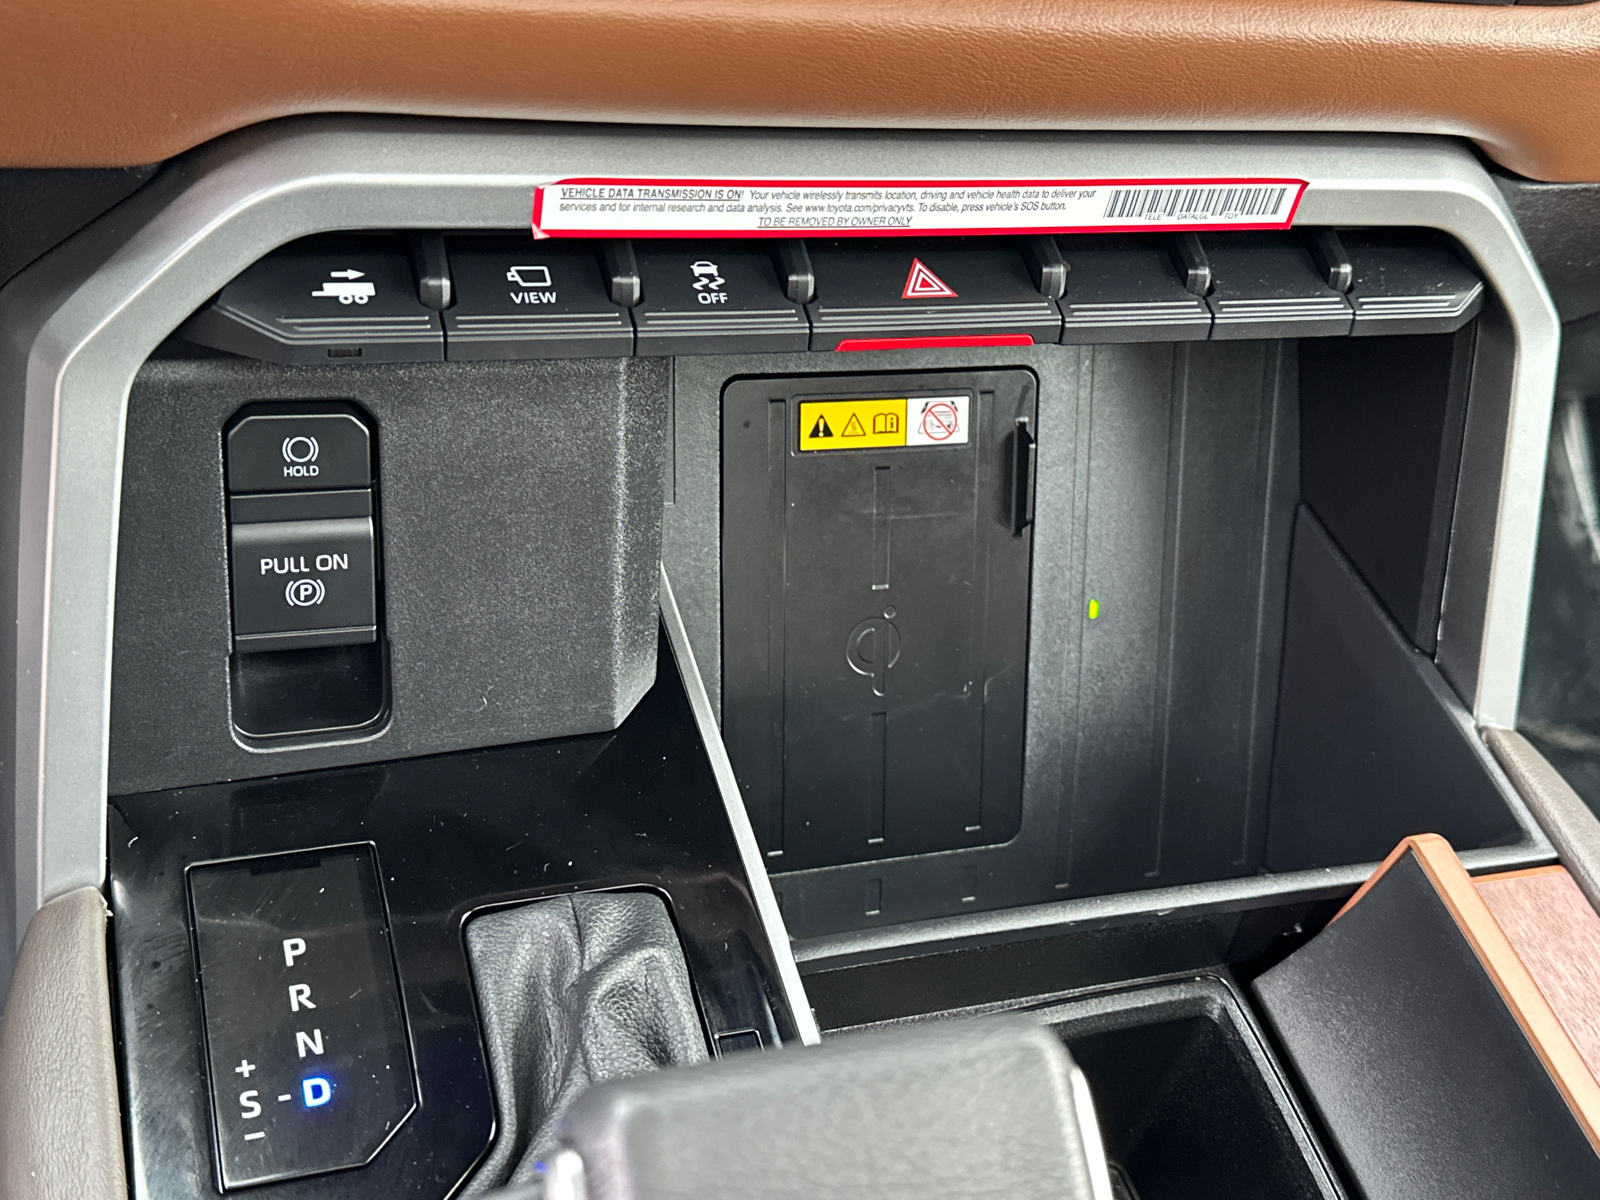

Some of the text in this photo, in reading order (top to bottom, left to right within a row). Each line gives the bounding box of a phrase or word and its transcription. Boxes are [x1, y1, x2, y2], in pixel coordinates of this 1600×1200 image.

[561, 188, 1097, 202] VEHICLE DATA TRANSMISSION IS ON! Your vehicle wirelessly transmits location, driving and vehicle health data to deliver your
[560, 201, 1066, 214] services and for internal research and data analysis. See www.toyota.com/privacyvts. To disable, press vehicle's SOS button.
[758, 216, 913, 226] TO BE REMOVED BY OWNER ONLY
[1143, 213, 1163, 221] TELE
[509, 291, 557, 305] VIEW
[697, 292, 728, 305] OFF
[282, 465, 319, 477] HOLD
[260, 553, 349, 575] PULL ON
[282, 937, 307, 967] P
[288, 983, 316, 1012] R
[295, 1028, 324, 1058] N
[239, 1089, 262, 1119] S
[302, 1076, 332, 1108] D
